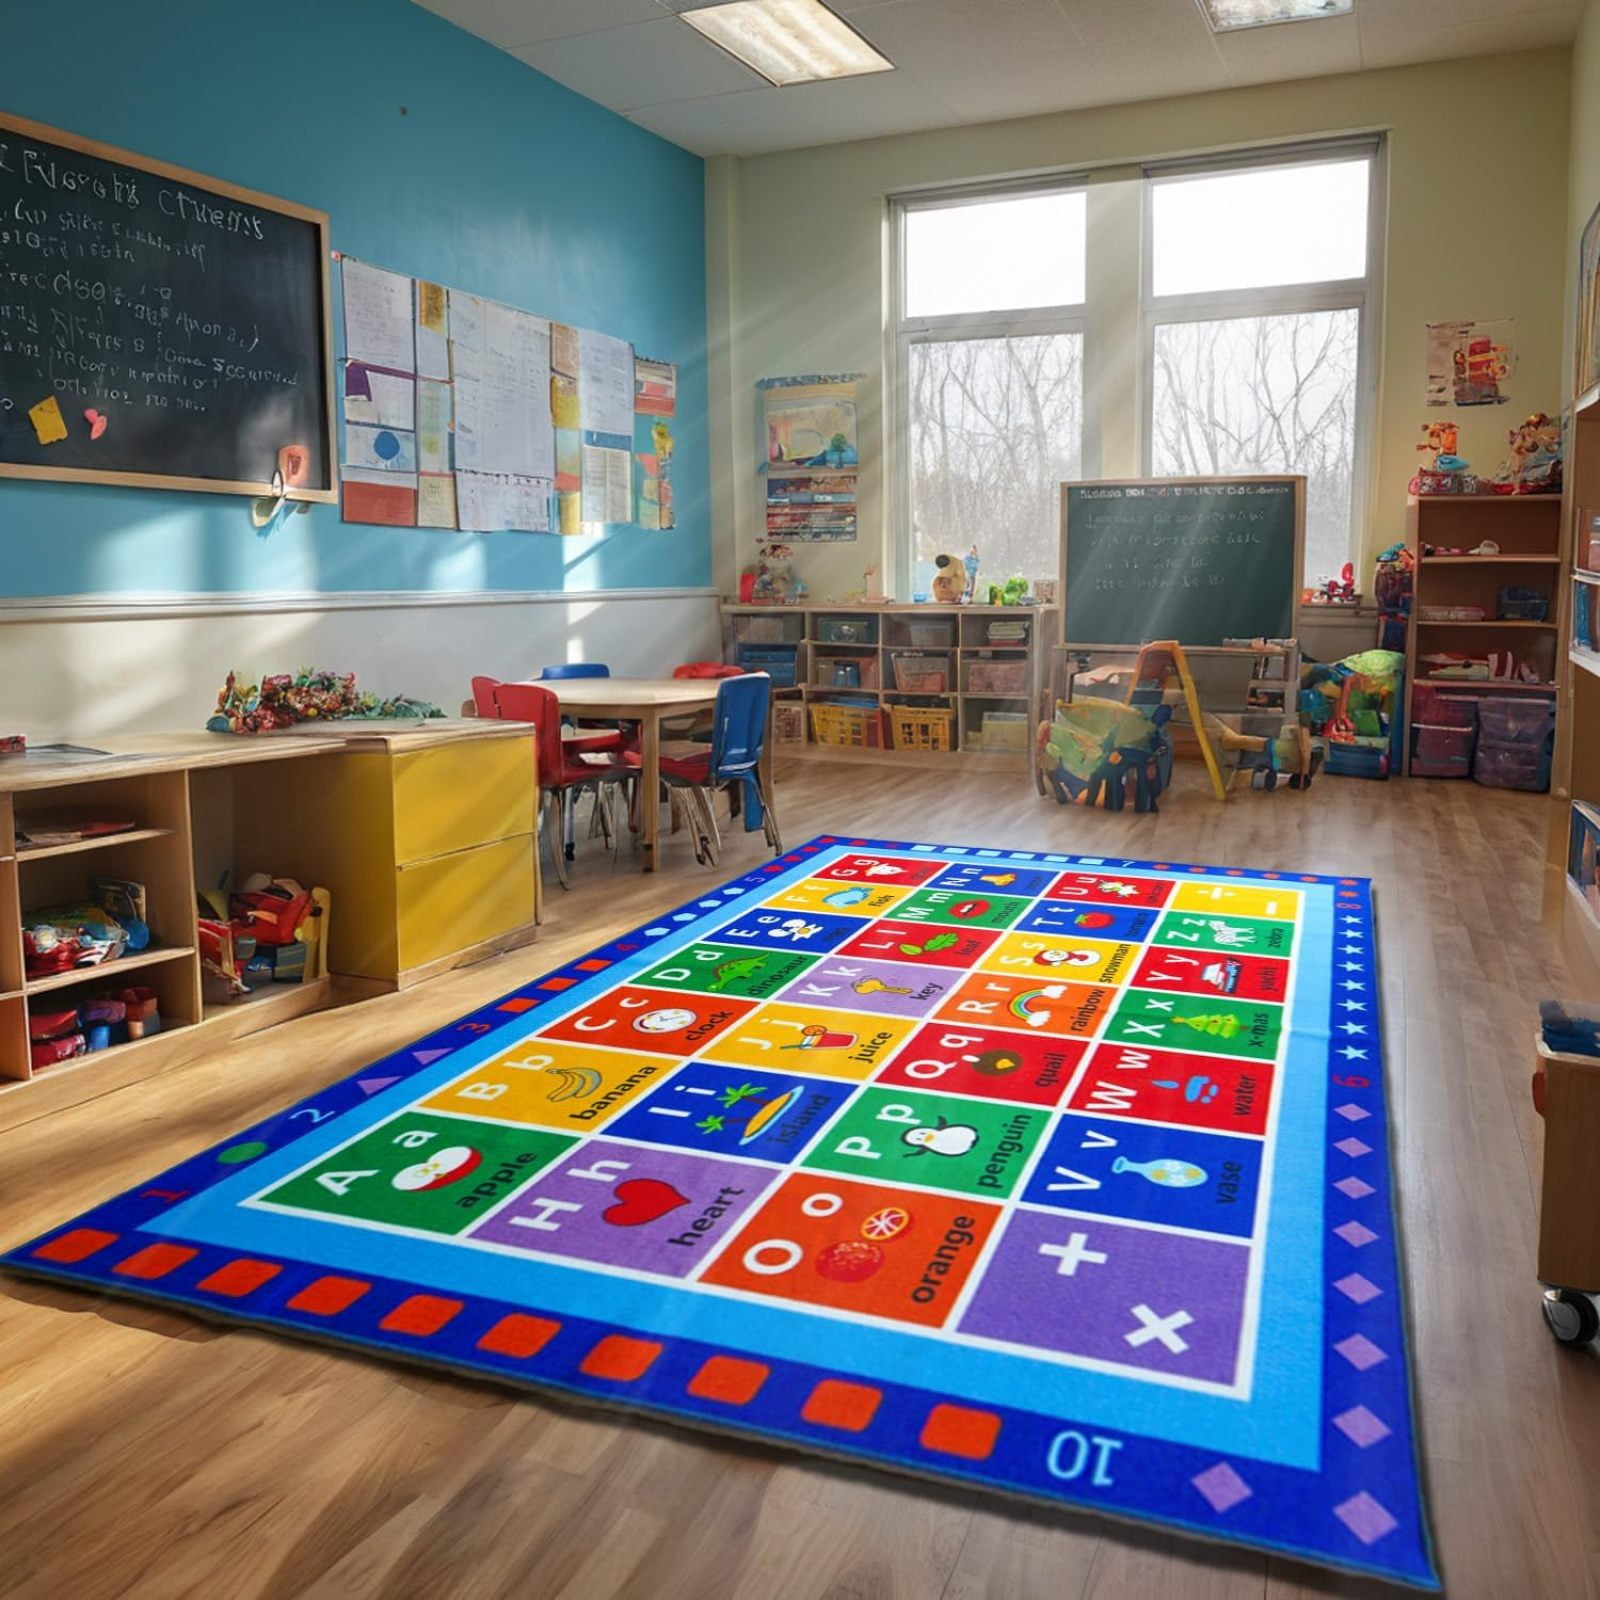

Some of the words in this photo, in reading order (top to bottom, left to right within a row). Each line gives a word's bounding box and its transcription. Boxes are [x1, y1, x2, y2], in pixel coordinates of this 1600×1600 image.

[831, 868, 858, 877] G
[940, 877, 971, 887] N
[785, 895, 809, 903] F
[868, 894, 895, 907] fish
[897, 907, 936, 920] M
[925, 892, 954, 903] m
[1059, 886, 1089, 896] U
[725, 928, 760, 938] E
[757, 916, 781, 924] e
[1032, 917, 1065, 926] T
[1166, 930, 1200, 942] Z
[1182, 918, 1207, 927] z
[617, 943, 639, 952] 4
[859, 941, 895, 949] L
[1000, 955, 1034, 967] S
[1022, 942, 1046, 950] s
[1267, 928, 1284, 950] zebra
[652, 968, 692, 981] D
[693, 950, 725, 961] d
[747, 955, 808, 995] dinosaur
[1100, 943, 1132, 983] snowman
[1146, 970, 1183, 981] Y
[1164, 954, 1200, 966] y
[798, 983, 841, 996] K
[823, 966, 864, 976] k
[910, 982, 944, 1000] key
[573, 1016, 617, 1031] C
[619, 997, 650, 1008] c
[957, 1000, 1000, 1014] R
[985, 982, 1011, 992] r
[1070, 989, 1106, 1032] rainbow
[457, 1022, 491, 1034] 3
[685, 1009, 735, 1042] clock
[737, 1036, 772, 1050] J
[760, 1018, 805, 1030] j
[1123, 1020, 1165, 1038] X
[1145, 999, 1175, 1012] x
[848, 1031, 893, 1064] juice
[904, 1060, 959, 1079] Q
[939, 1033, 984, 1048] q
[456, 1082, 510, 1101] B
[503, 1055, 555, 1071] b
[1035, 1053, 1067, 1087] quail
[1085, 1081, 1137, 1109] W
[1116, 1049, 1151, 1069] w
[569, 1065, 659, 1121] banana
[674, 1085, 717, 1096] i
[1234, 1074, 1257, 1116] water
[289, 1108, 336, 1123] 2
[767, 1094, 833, 1146] island
[834, 1135, 882, 1160] P
[875, 1104, 922, 1125] p
[315, 1169, 381, 1196] A
[392, 1130, 439, 1148] a
[977, 1114, 1033, 1190] penguin
[1047, 1166, 1102, 1191] V
[1080, 1130, 1118, 1148] v
[140, 1189, 190, 1204] 1
[453, 1152, 538, 1209] apple
[509, 1198, 584, 1231] H
[566, 1160, 632, 1183] h
[1216, 1160, 1244, 1205] vase
[667, 1186, 745, 1247] heart
[743, 1239, 803, 1275] O
[802, 1193, 843, 1217] o
[911, 1216, 976, 1304] orange
[1046, 1430, 1124, 1486] 10
